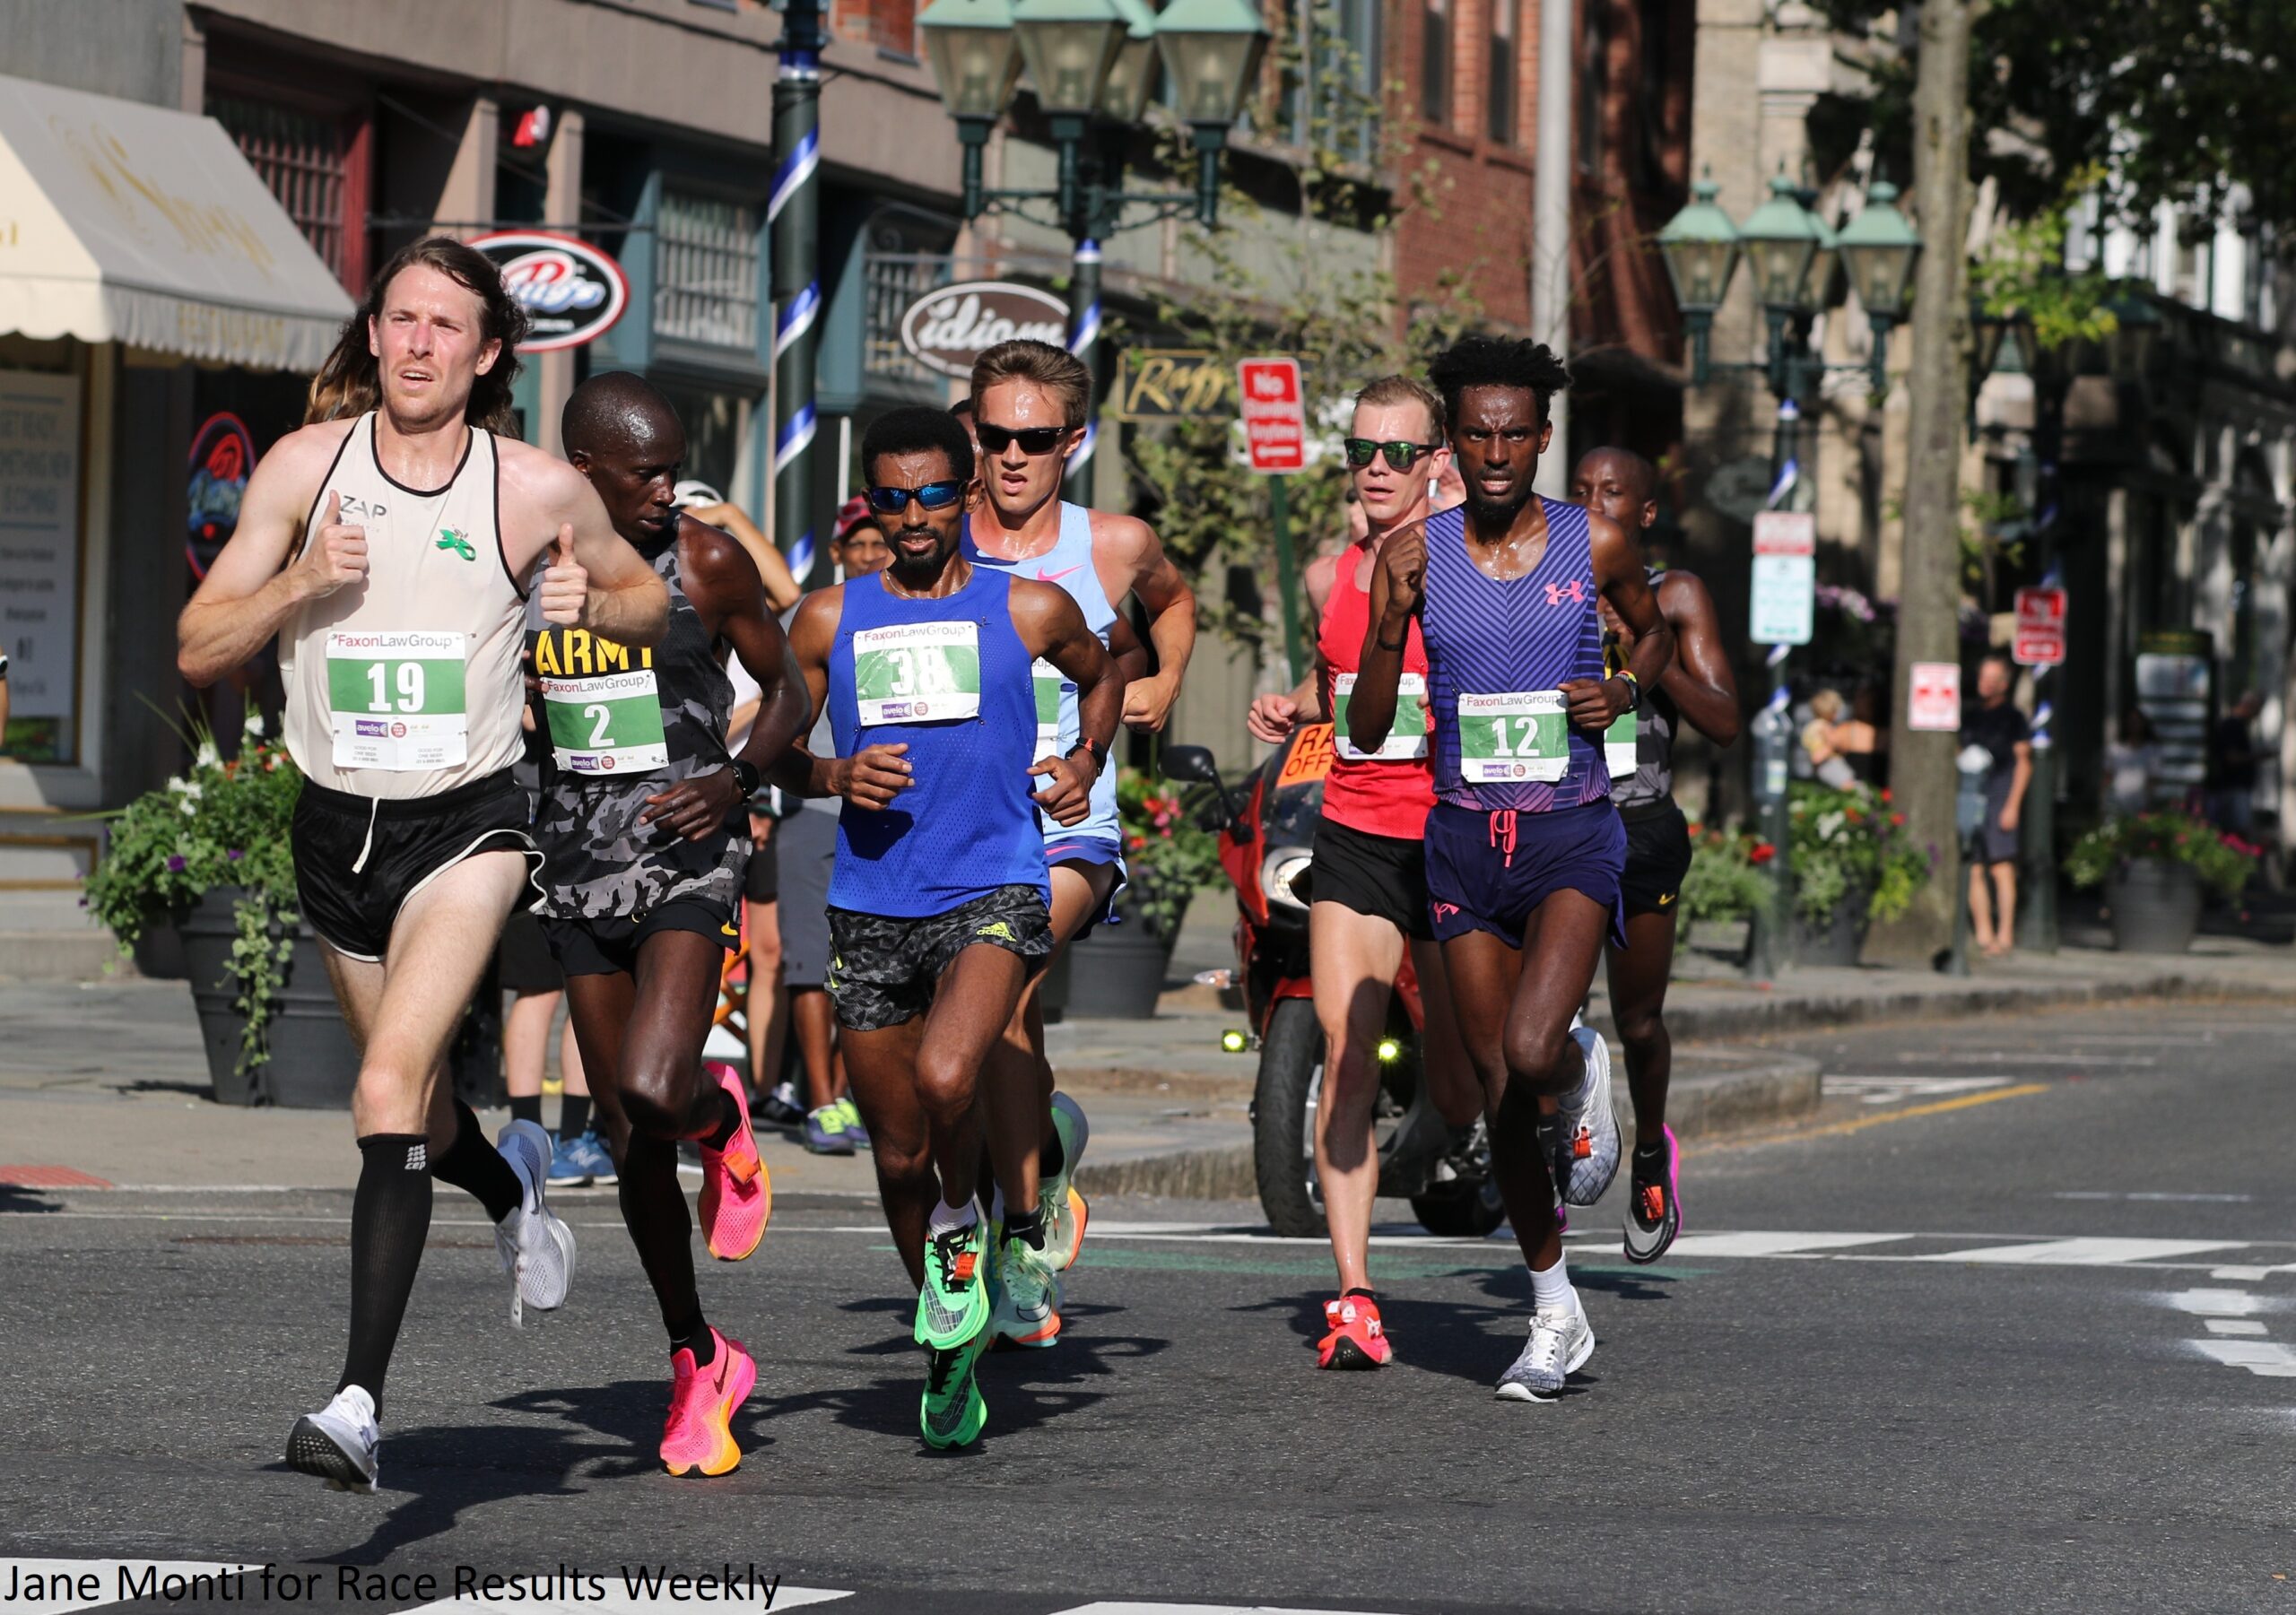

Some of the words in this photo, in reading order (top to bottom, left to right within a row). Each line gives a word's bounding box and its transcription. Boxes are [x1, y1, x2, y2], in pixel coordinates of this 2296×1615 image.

[1253, 370, 1285, 397] No
[337, 634, 452, 649] FaxonLawGroup
[864, 624, 966, 642] FaxonLawGroup
[888, 647, 944, 696] 38
[367, 662, 424, 713] 19
[547, 675, 645, 694] FaxonLawGroup
[1466, 694, 1559, 707] FaxonLawGroup
[357, 724, 379, 734] avelo
[584, 704, 615, 748] 2
[1492, 716, 1540, 757] 12
